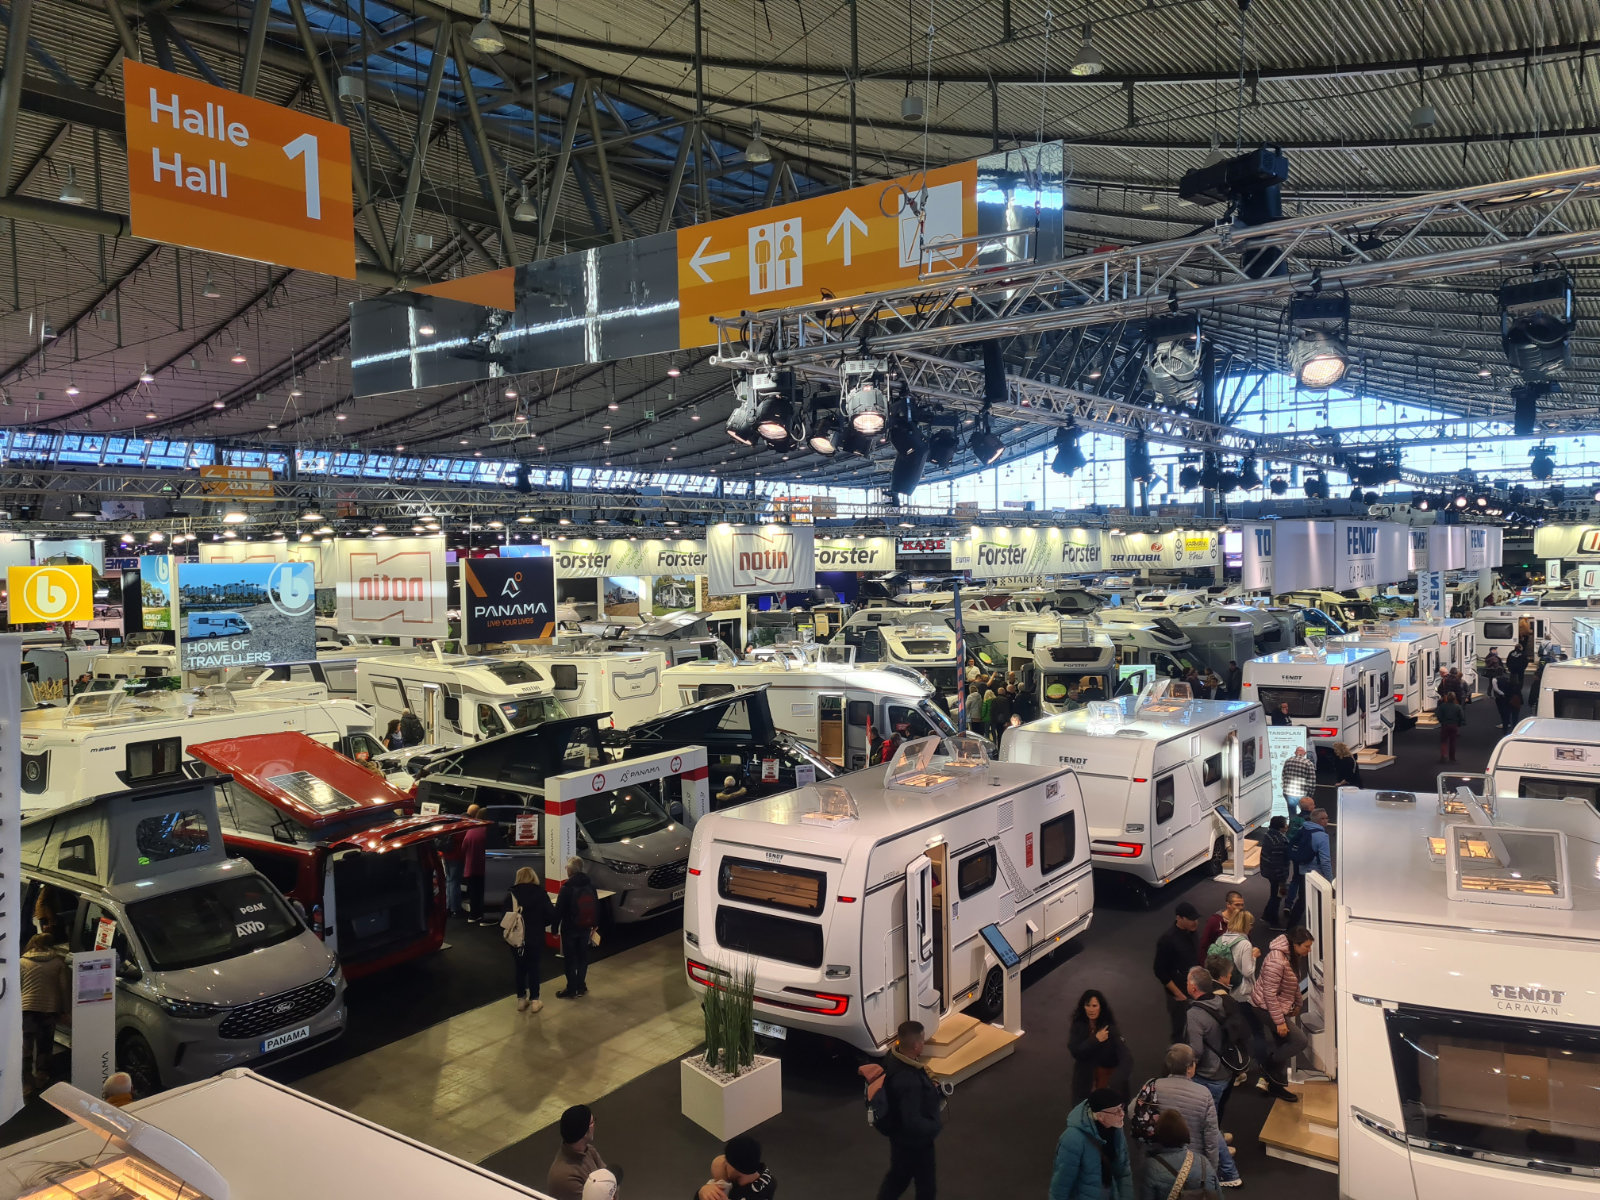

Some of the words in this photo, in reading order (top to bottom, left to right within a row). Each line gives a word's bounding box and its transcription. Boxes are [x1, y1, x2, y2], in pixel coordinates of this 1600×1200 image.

[149, 87, 249, 147] Halle
[152, 147, 228, 198] Hall
[282, 133, 321, 220] 1
[902, 540, 946, 551] KABE
[1346, 526, 1378, 555] FENDT
[657, 551, 708, 567] Forster
[739, 550, 789, 571] notin
[977, 544, 1027, 566] Forster
[1062, 543, 1101, 563] Forster
[1127, 554, 1162, 562] MOBIL
[1007, 576, 1034, 584] START
[1348, 564, 1375, 584] CARAVAN
[474, 602, 548, 618] PANAMA
[487, 620, 500, 628] LIVE
[518, 617, 534, 625] LIVES
[187, 641, 229, 653] HOME
[231, 640, 250, 650] OF
[187, 652, 271, 668] TRAVELLERS
[1058, 755, 1089, 765] FENDT
[630, 766, 660, 778] PANAMA
[235, 920, 266, 938] AWD
[1490, 984, 1567, 1004] FENDT
[1497, 1001, 1559, 1016] CARAVAN
[267, 1029, 306, 1049] PANAMA
